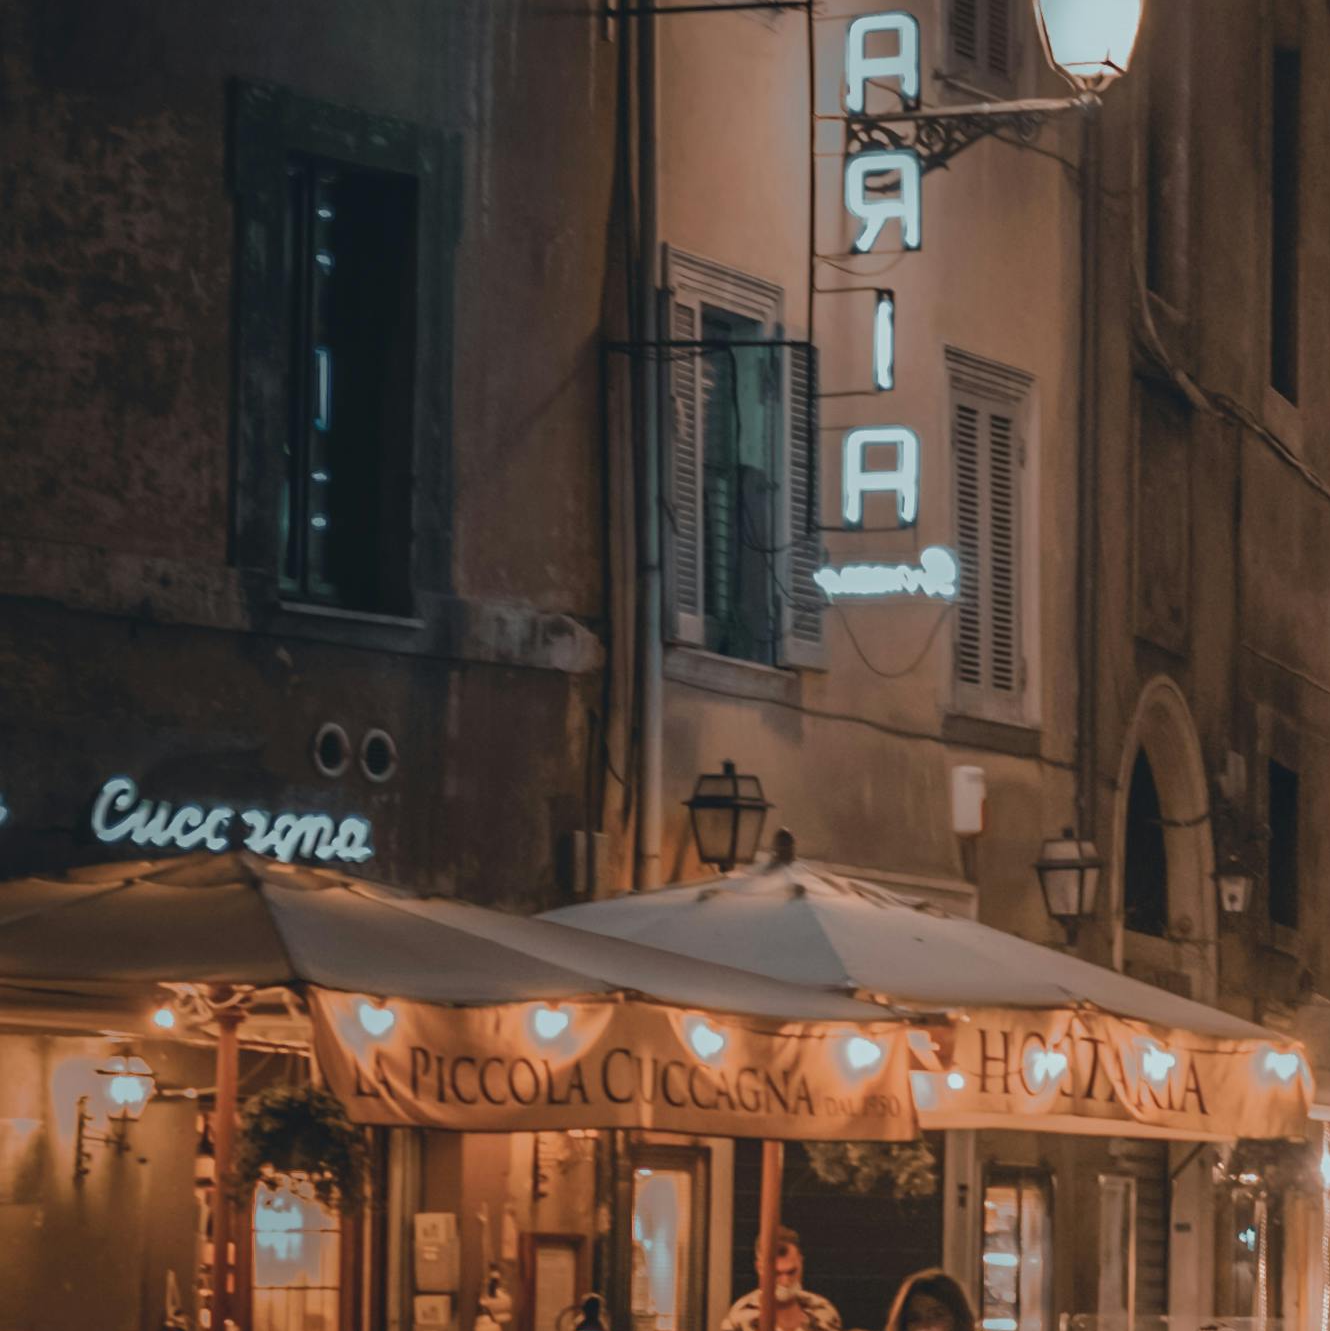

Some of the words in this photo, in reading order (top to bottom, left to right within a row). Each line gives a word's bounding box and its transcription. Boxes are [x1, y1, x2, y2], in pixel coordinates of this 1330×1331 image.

[353, 1051, 396, 1100] LA
[410, 1047, 590, 1106] PICCOLA
[602, 1047, 815, 1116] CUCCAGNA
